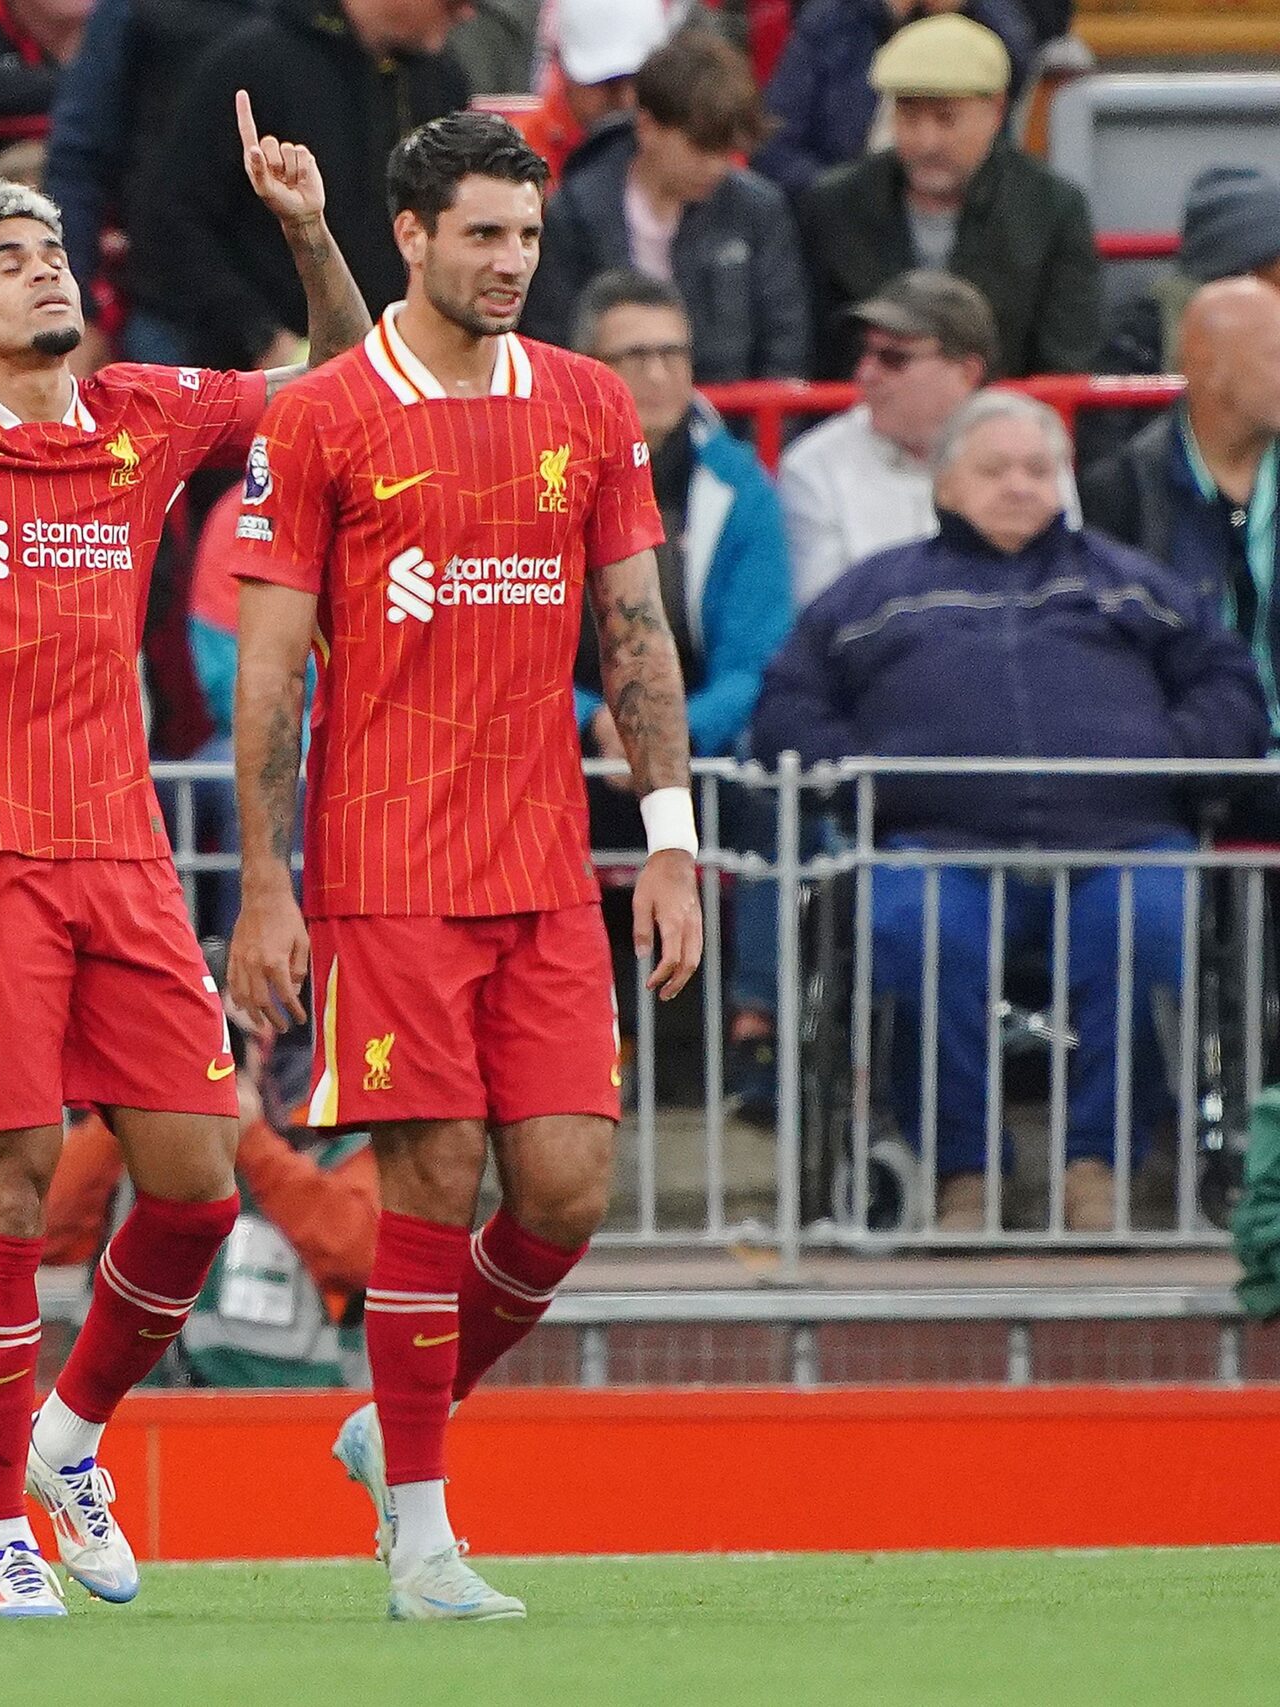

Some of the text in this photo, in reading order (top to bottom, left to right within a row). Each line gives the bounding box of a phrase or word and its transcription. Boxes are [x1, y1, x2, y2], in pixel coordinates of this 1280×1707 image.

[22, 518, 130, 545] standard
[22, 543, 133, 570] chartered
[436, 579, 566, 606] chartered
